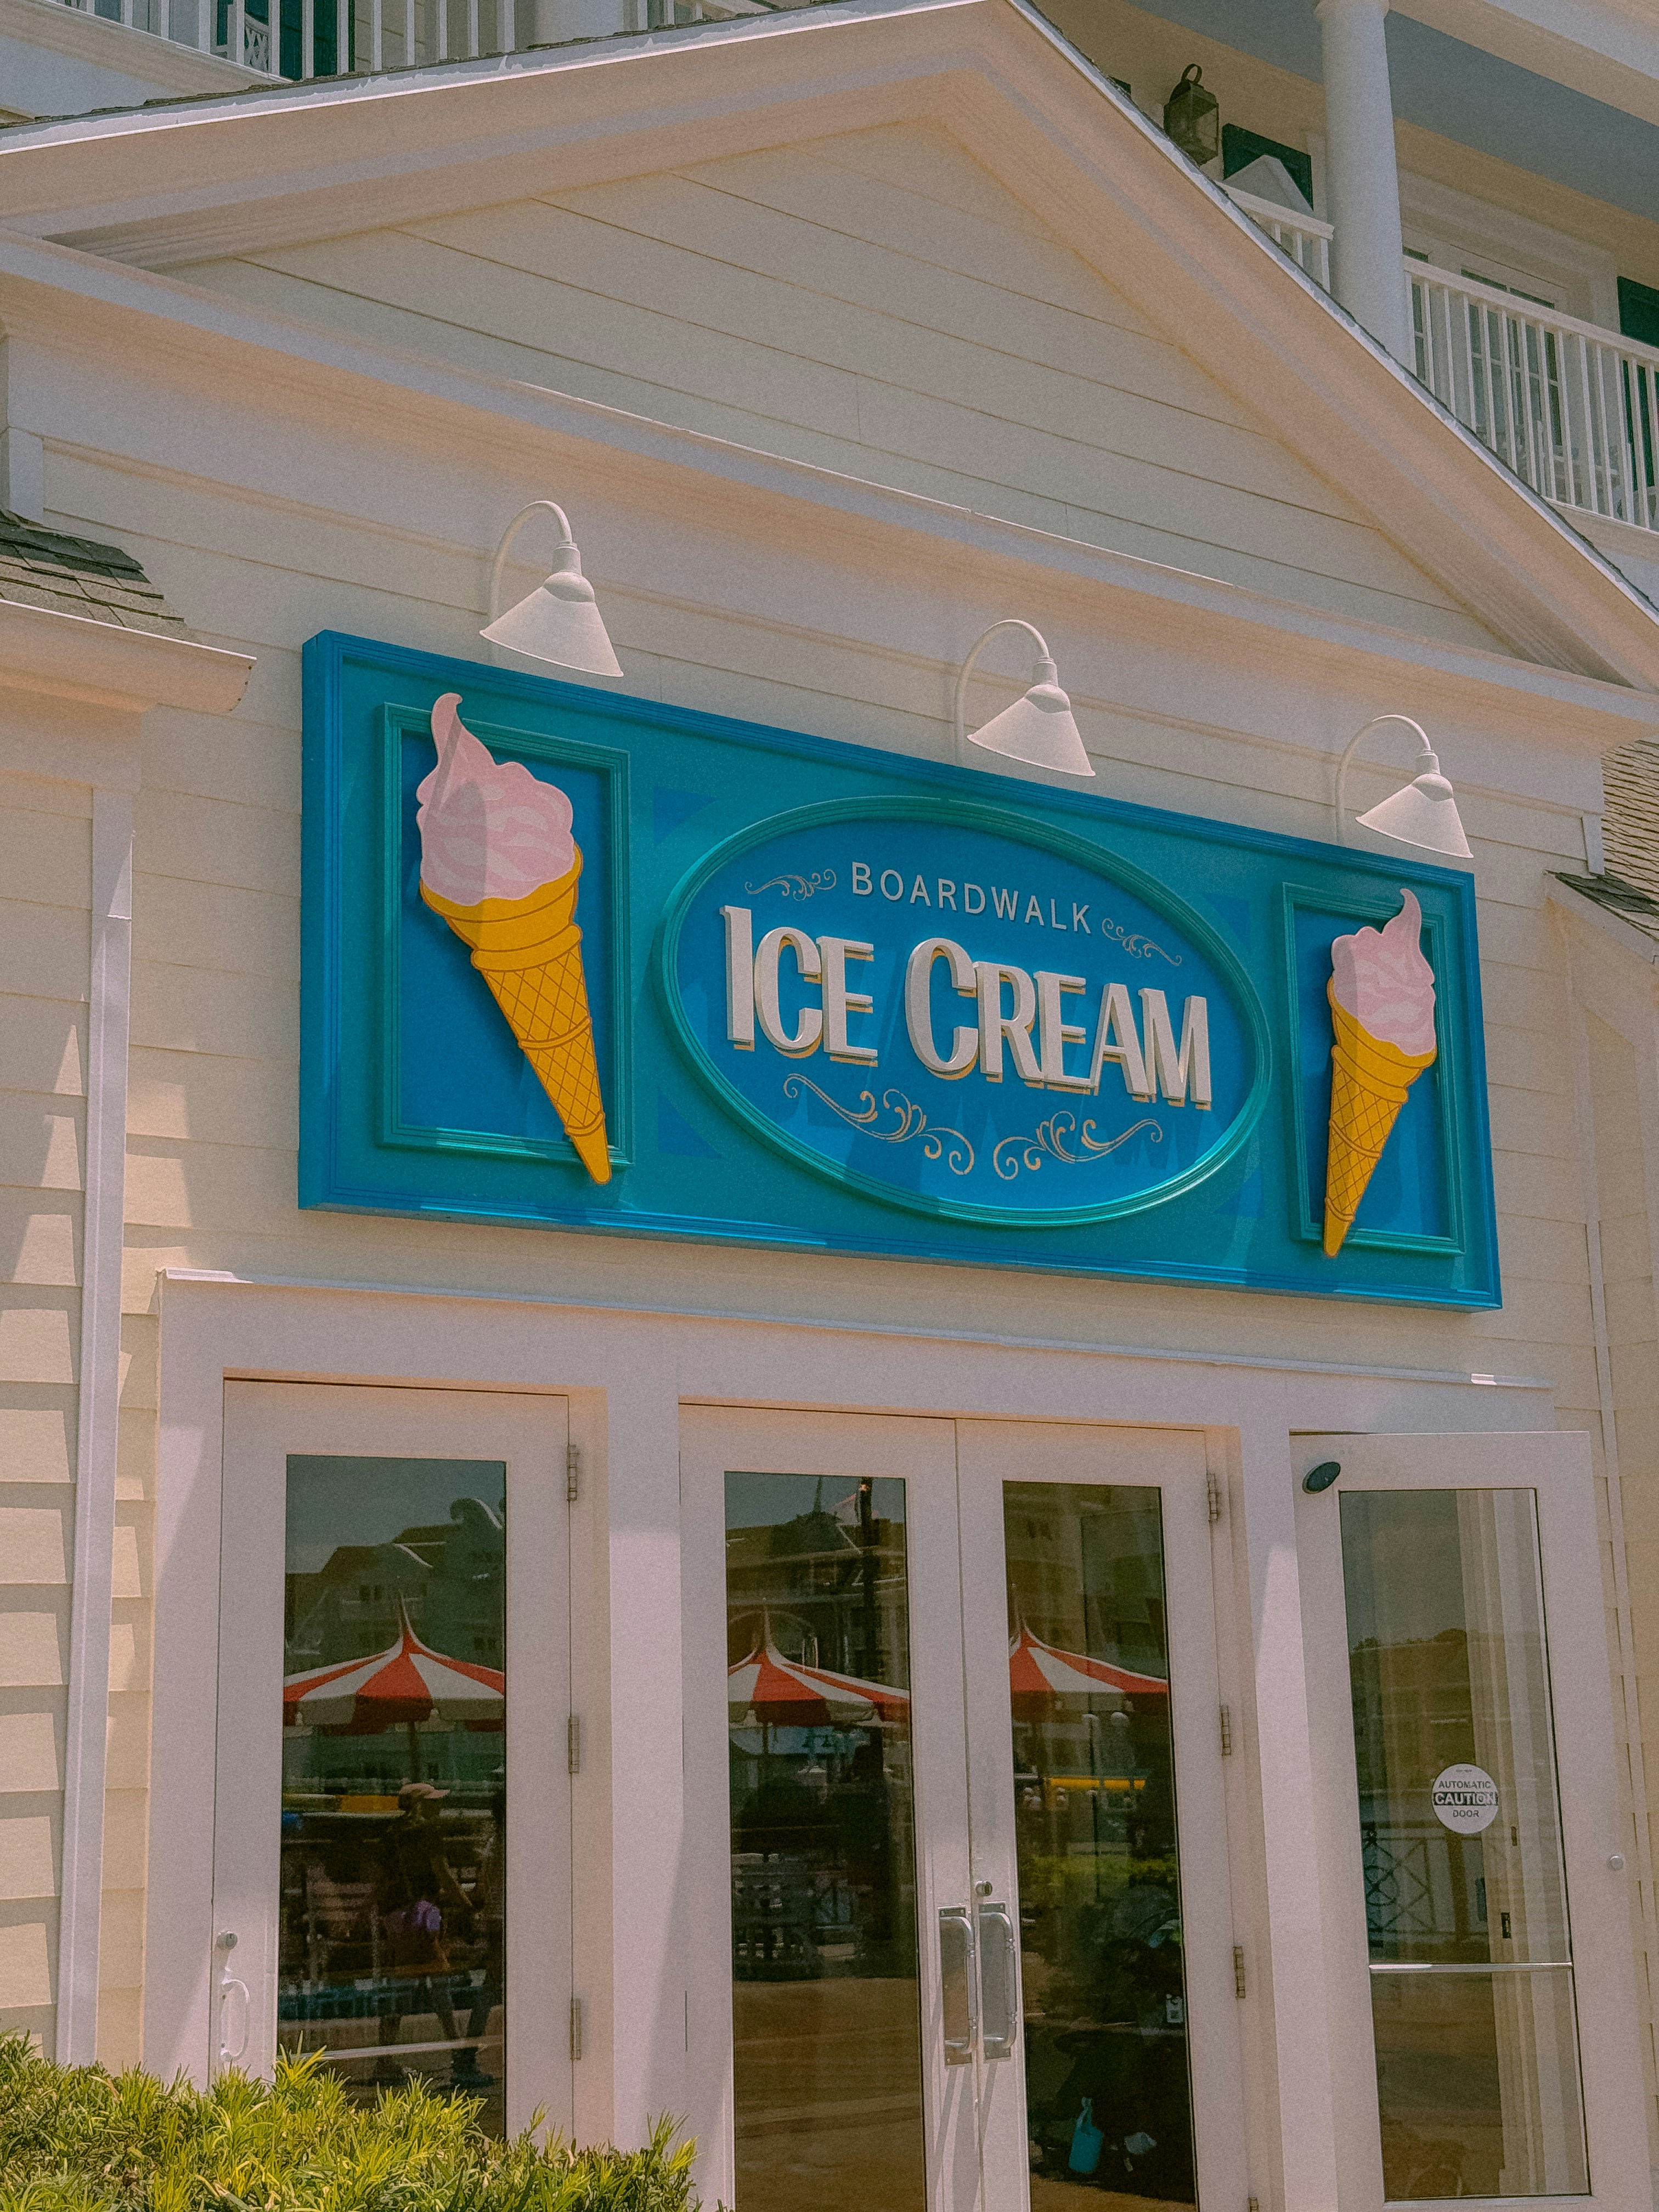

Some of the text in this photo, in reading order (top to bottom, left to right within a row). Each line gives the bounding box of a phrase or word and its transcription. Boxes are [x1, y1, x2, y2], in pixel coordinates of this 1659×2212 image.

[850, 861, 1093, 935] BOARDWALK
[719, 905, 1212, 1111] ICE CREAM
[1435, 1793, 1497, 1804] CAUTION
